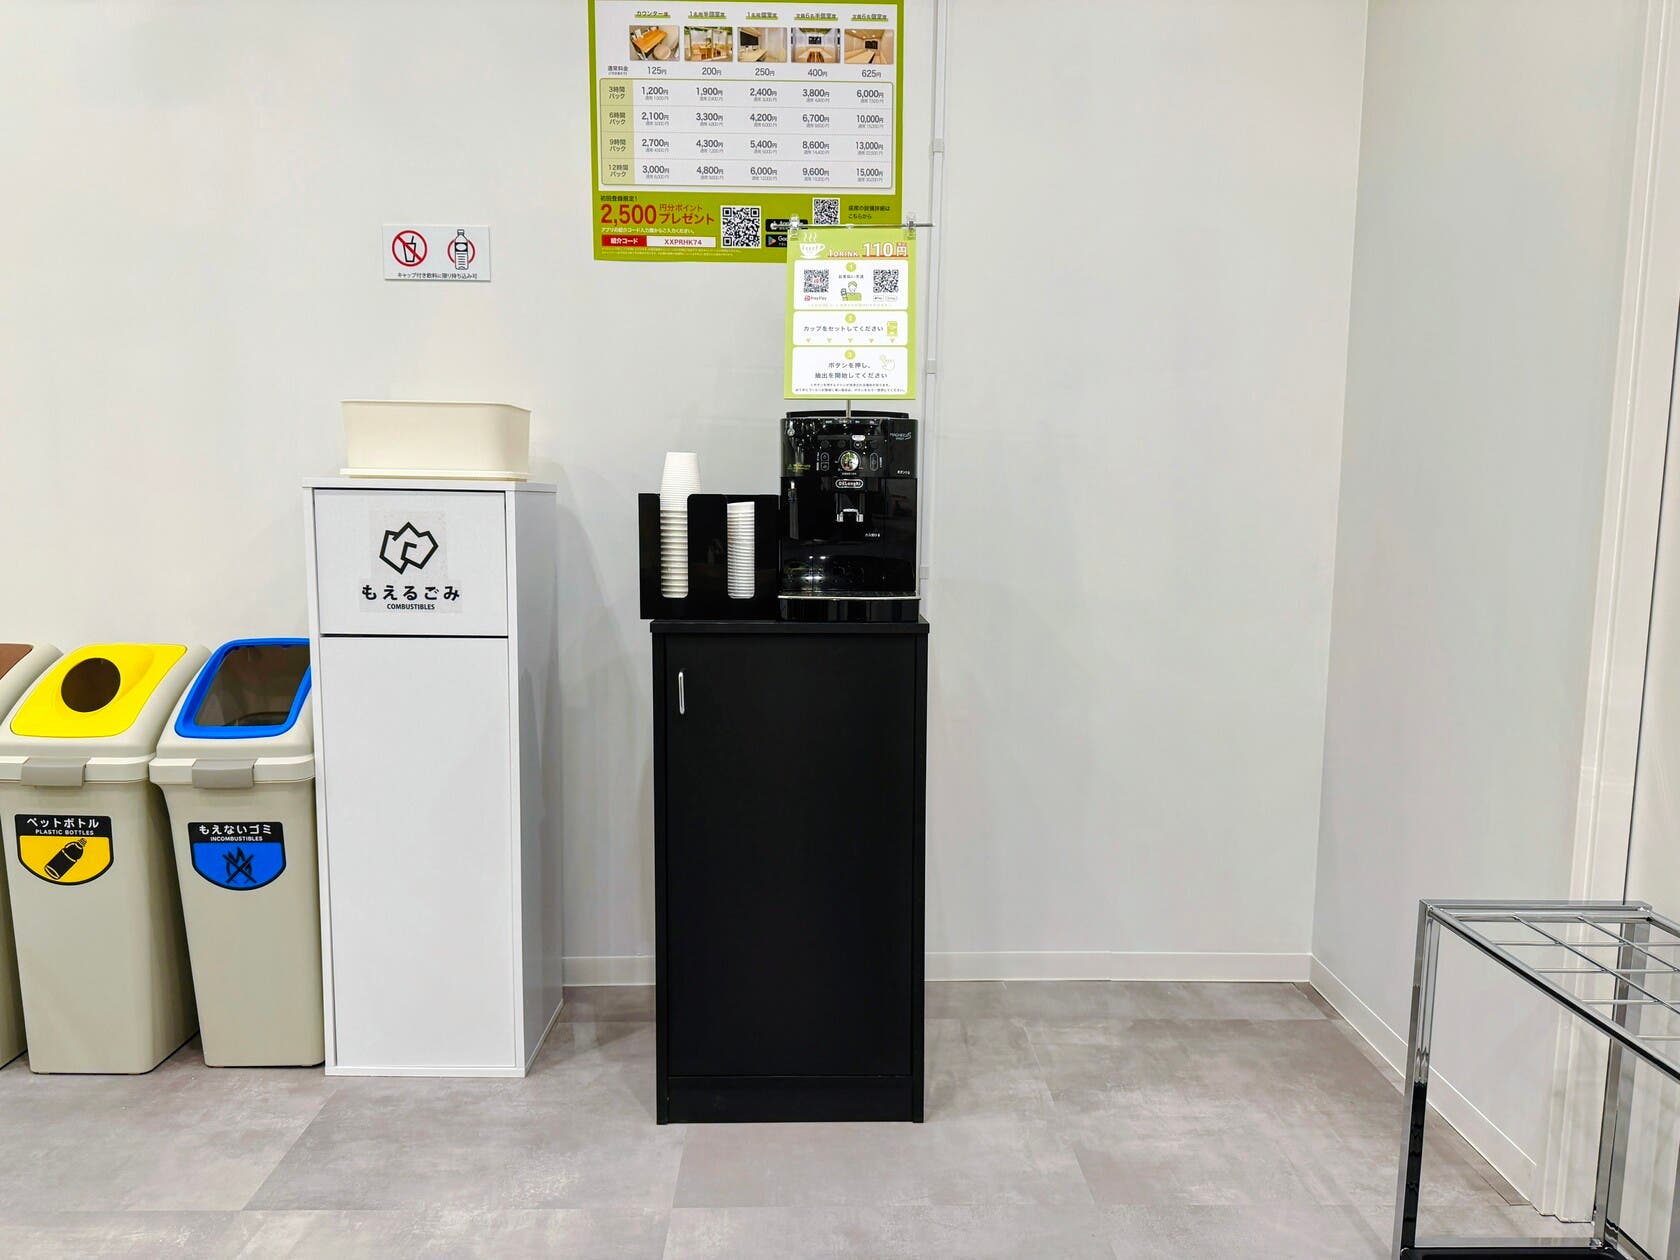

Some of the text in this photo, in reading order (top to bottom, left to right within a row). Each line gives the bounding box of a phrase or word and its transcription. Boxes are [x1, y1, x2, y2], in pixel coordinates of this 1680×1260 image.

[647, 67, 667, 75] 125円
[702, 67, 722, 76] 200円
[755, 68, 775, 76] 250円
[808, 69, 828, 77] 400円
[861, 70, 882, 78] 625円
[641, 86, 669, 96] 1,200円
[695, 87, 723, 97] 1,900円
[750, 88, 777, 97] 2,400円
[802, 89, 830, 98] 3,800円
[856, 90, 884, 98] 6,000円
[641, 112, 669, 121] 2,100円
[695, 113, 723, 122] 3,300円
[750, 114, 777, 122] 4,200円
[802, 114, 830, 123] 6,700円
[856, 115, 884, 124] 10,000円
[641, 139, 669, 148] 2,700円
[695, 140, 723, 149] 4,300円
[750, 140, 777, 149] 5,400円
[802, 141, 830, 150] 8,600円
[855, 142, 884, 151] 13,000円
[642, 165, 670, 175] 3,000円
[696, 166, 724, 176] 4,800円
[750, 167, 777, 176] 6,000円
[802, 168, 830, 177] 9,600円
[856, 168, 884, 178] 15,000円
[600, 203, 703, 226] 2,500 円分ポイント
[660, 213, 715, 225] プレゼント
[863, 242, 907, 257] 110円
[361, 584, 460, 601] もえるごみ
[27, 817, 99, 829] ペットボトル
[199, 824, 272, 835] もえないゴミ
